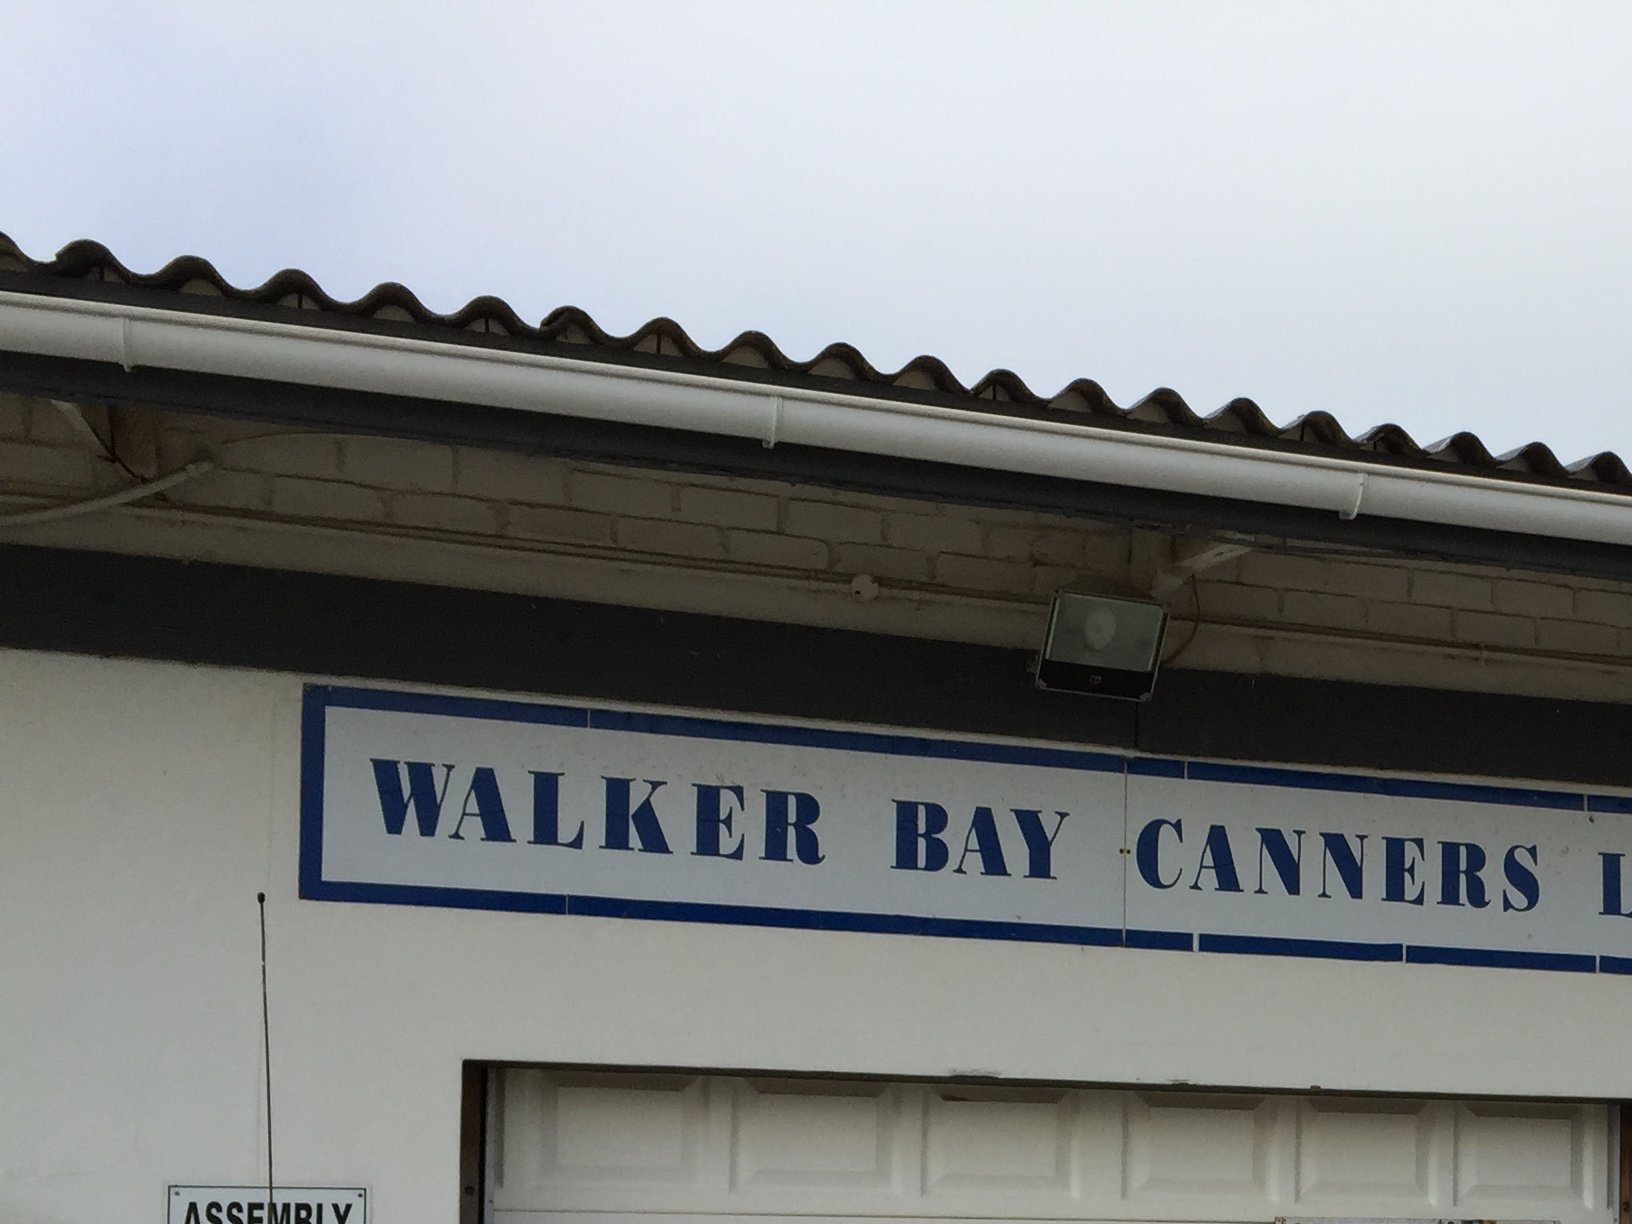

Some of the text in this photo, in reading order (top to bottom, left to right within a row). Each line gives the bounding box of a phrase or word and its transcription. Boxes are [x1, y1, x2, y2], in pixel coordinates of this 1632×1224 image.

[370, 757, 826, 867] WALKER
[889, 798, 1071, 882] BAY
[1135, 818, 1541, 914] CANNERS
